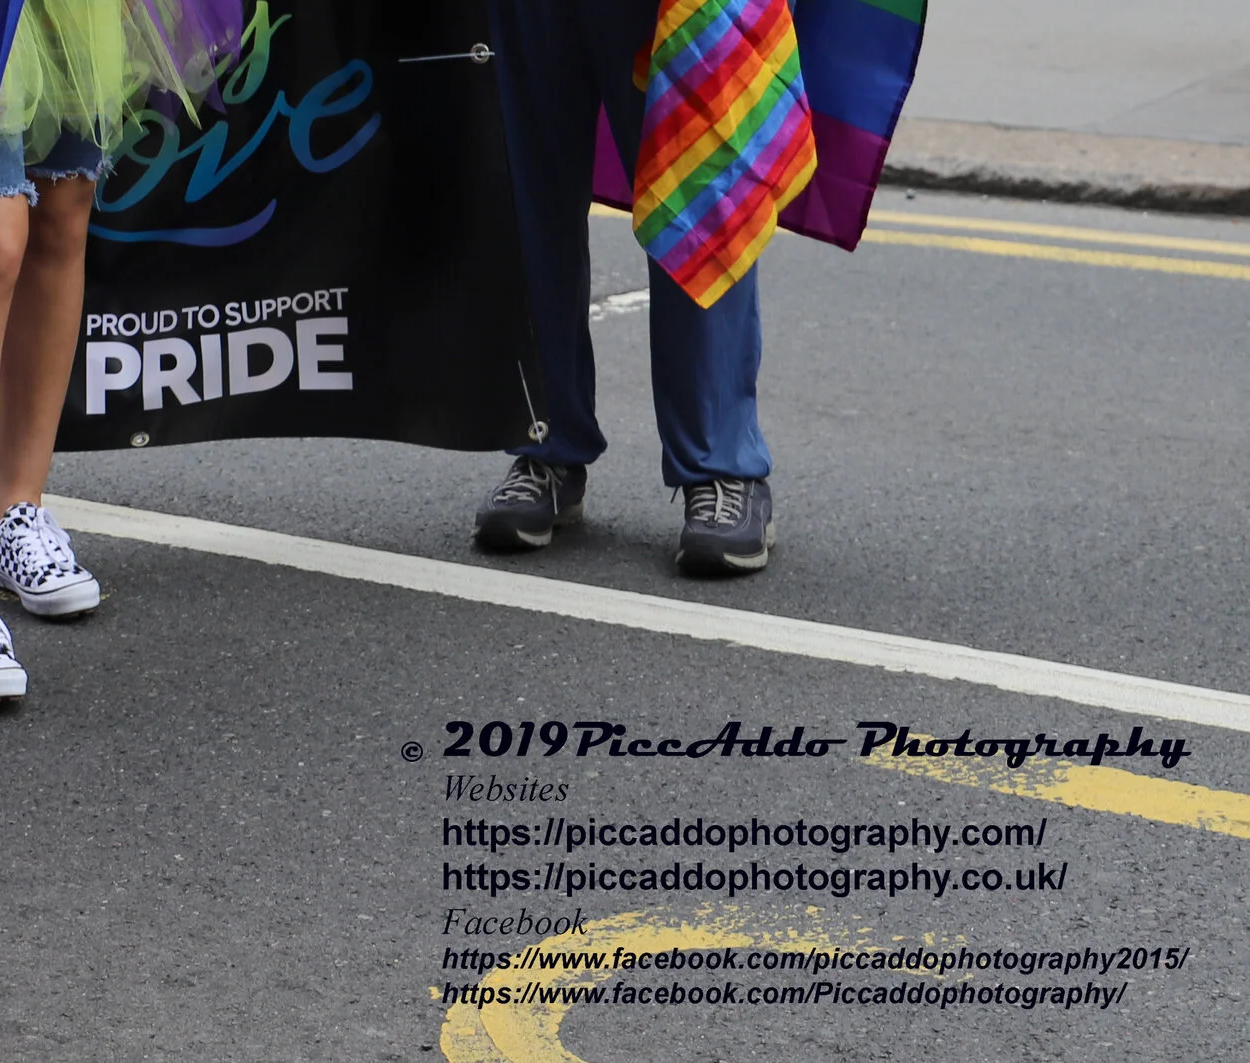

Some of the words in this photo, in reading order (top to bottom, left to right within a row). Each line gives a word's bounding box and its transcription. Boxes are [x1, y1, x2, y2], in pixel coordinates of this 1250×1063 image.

[96, 59, 382, 213] ove
[86, 309, 178, 336] PROUD
[181, 303, 221, 329] TO
[224, 288, 349, 327] SUPPORT
[85, 316, 354, 416] PRIDE
